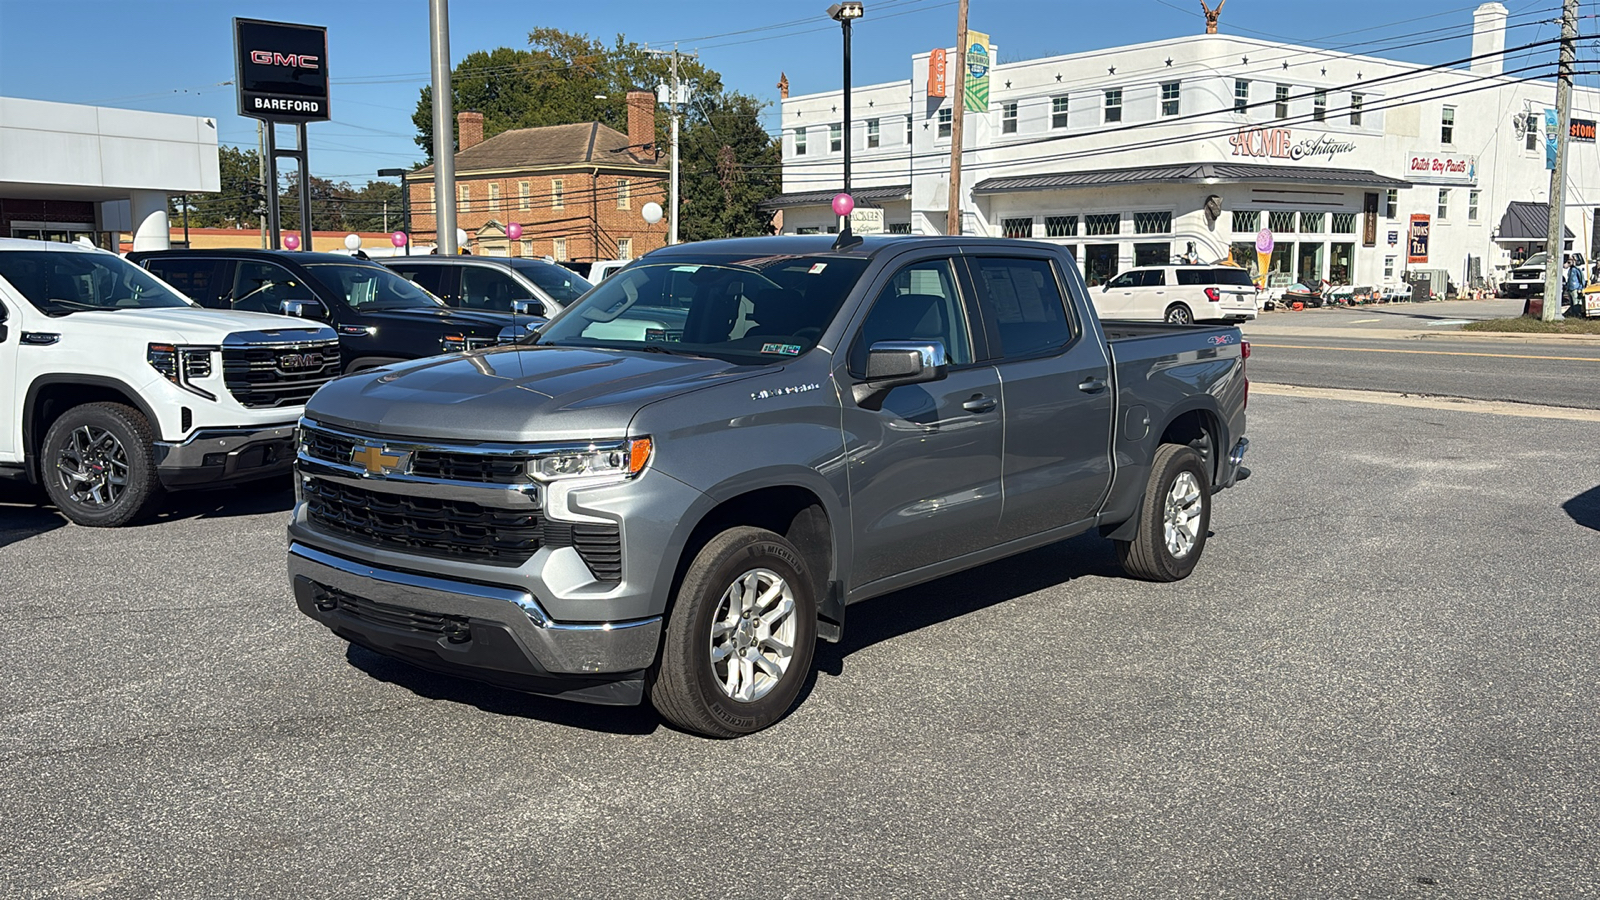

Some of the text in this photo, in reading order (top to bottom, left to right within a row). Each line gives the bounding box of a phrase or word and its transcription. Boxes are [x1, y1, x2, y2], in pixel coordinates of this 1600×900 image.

[250, 50, 319, 69] GMC
[936, 52, 944, 93] ACME
[254, 98, 319, 112] BAREFORD
[1228, 127, 1292, 159] ACME
[1411, 157, 1466, 175] Dutch Boy Paints
[1412, 241, 1426, 254] TEA
[281, 353, 323, 368] GMC
[767, 545, 802, 572] MICHELIN
[712, 704, 754, 728] MICHELIN
